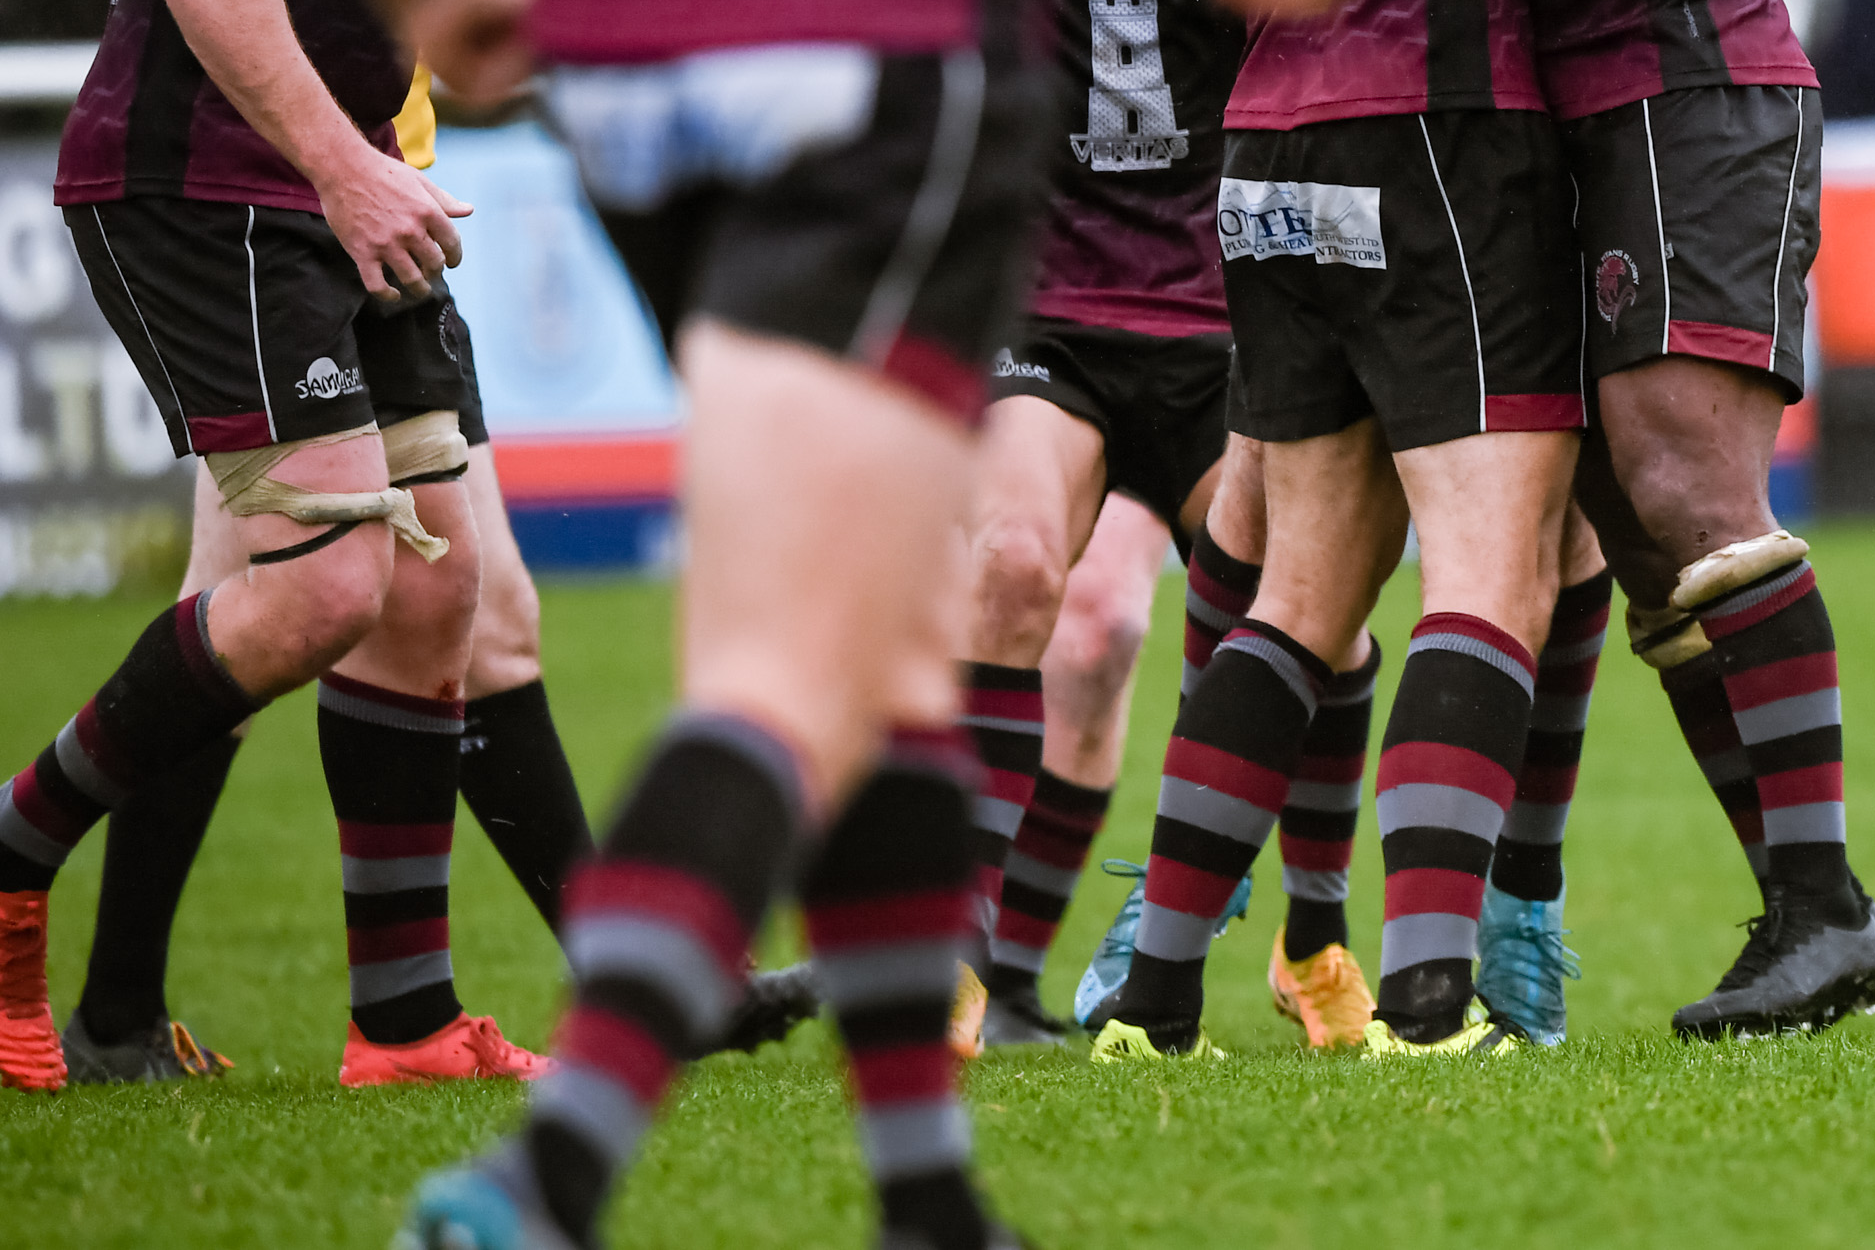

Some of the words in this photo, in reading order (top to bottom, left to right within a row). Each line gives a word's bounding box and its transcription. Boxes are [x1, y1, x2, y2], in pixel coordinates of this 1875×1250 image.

[1070, 136, 1189, 164] VERITAS
[1361, 236, 1379, 248] LTD
[294, 367, 361, 400] SAMURAI
